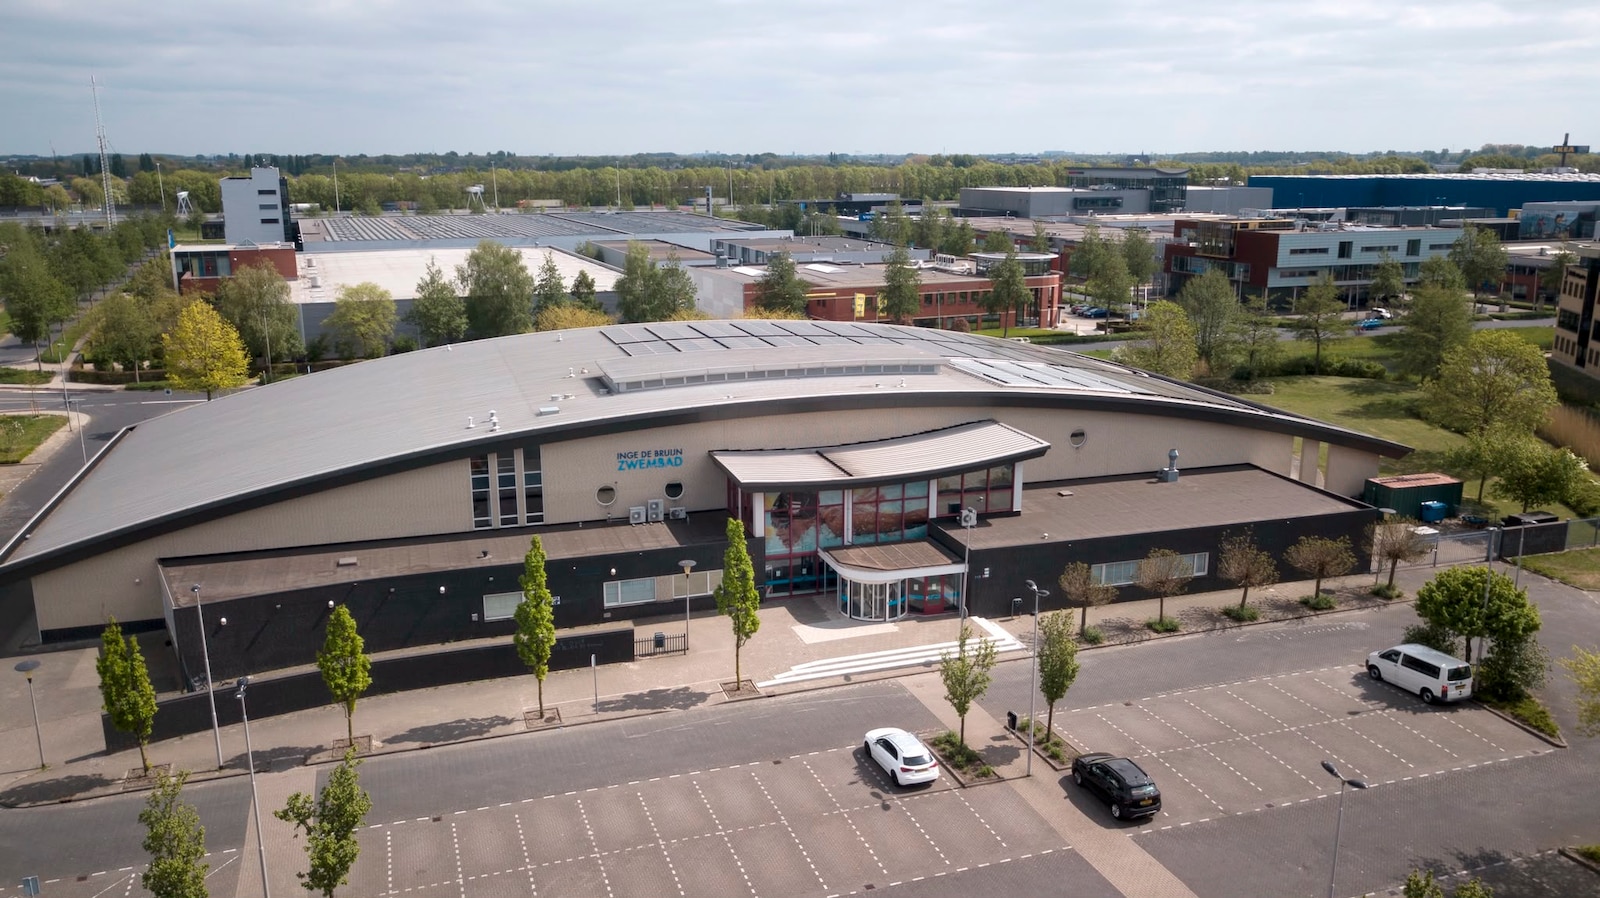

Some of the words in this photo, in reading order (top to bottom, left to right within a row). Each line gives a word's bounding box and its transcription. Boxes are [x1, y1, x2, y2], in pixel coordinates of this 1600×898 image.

[617, 451, 638, 460] INGE
[641, 450, 652, 458] DE
[654, 448, 683, 457] BRUIJN
[617, 456, 683, 471] ZWEMBAD
